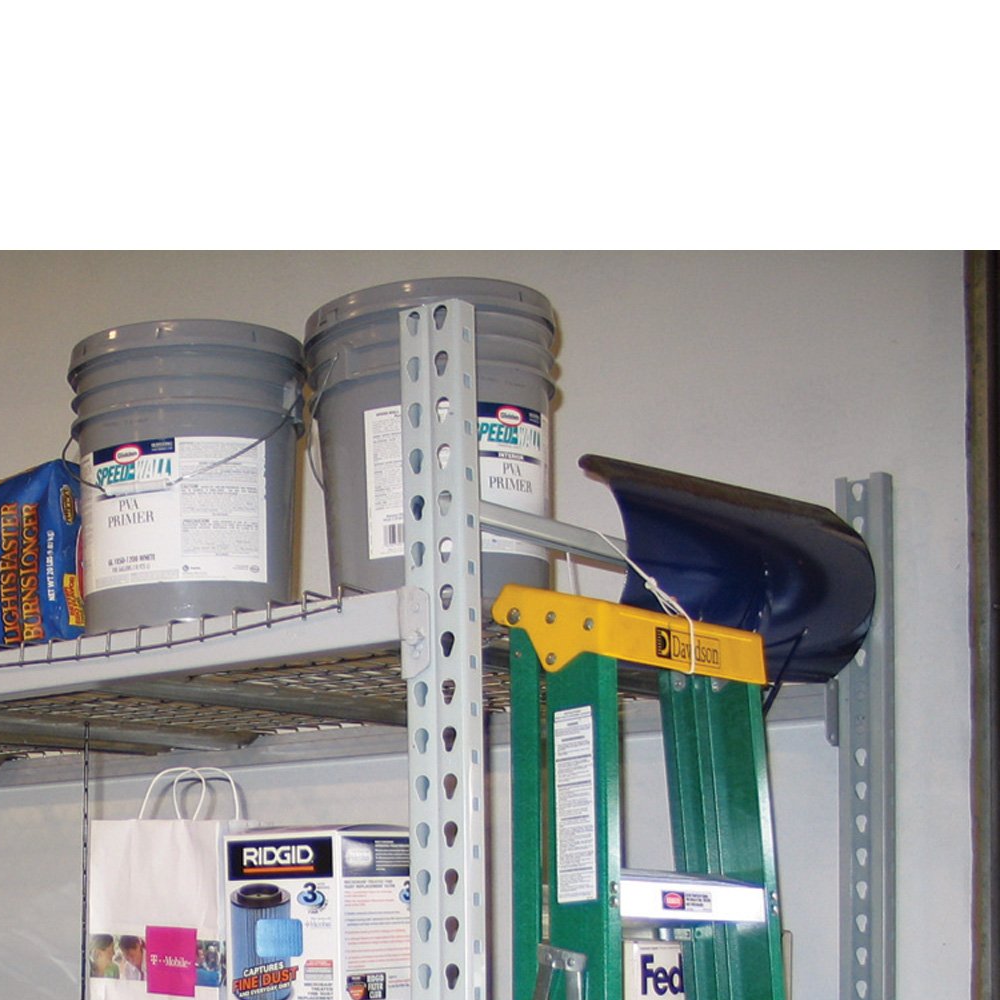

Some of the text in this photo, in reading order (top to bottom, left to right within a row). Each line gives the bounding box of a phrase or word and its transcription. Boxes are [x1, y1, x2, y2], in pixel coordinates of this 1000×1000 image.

[503, 462, 521, 478] PVA
[489, 475, 533, 494] PRIMER
[119, 498, 139, 513] PVA
[107, 510, 155, 528] PRIMER
[0, 502, 22, 645] LIGHTS FASTER
[20, 503, 45, 641] BURNS LONGER
[671, 637, 719, 665] Davdson
[242, 845, 314, 866] RIDGID
[303, 882, 317, 903] 3
[233, 967, 299, 992] FINE DUST
[243, 961, 284, 977] CAPTURES
[640, 953, 685, 996] Fed
